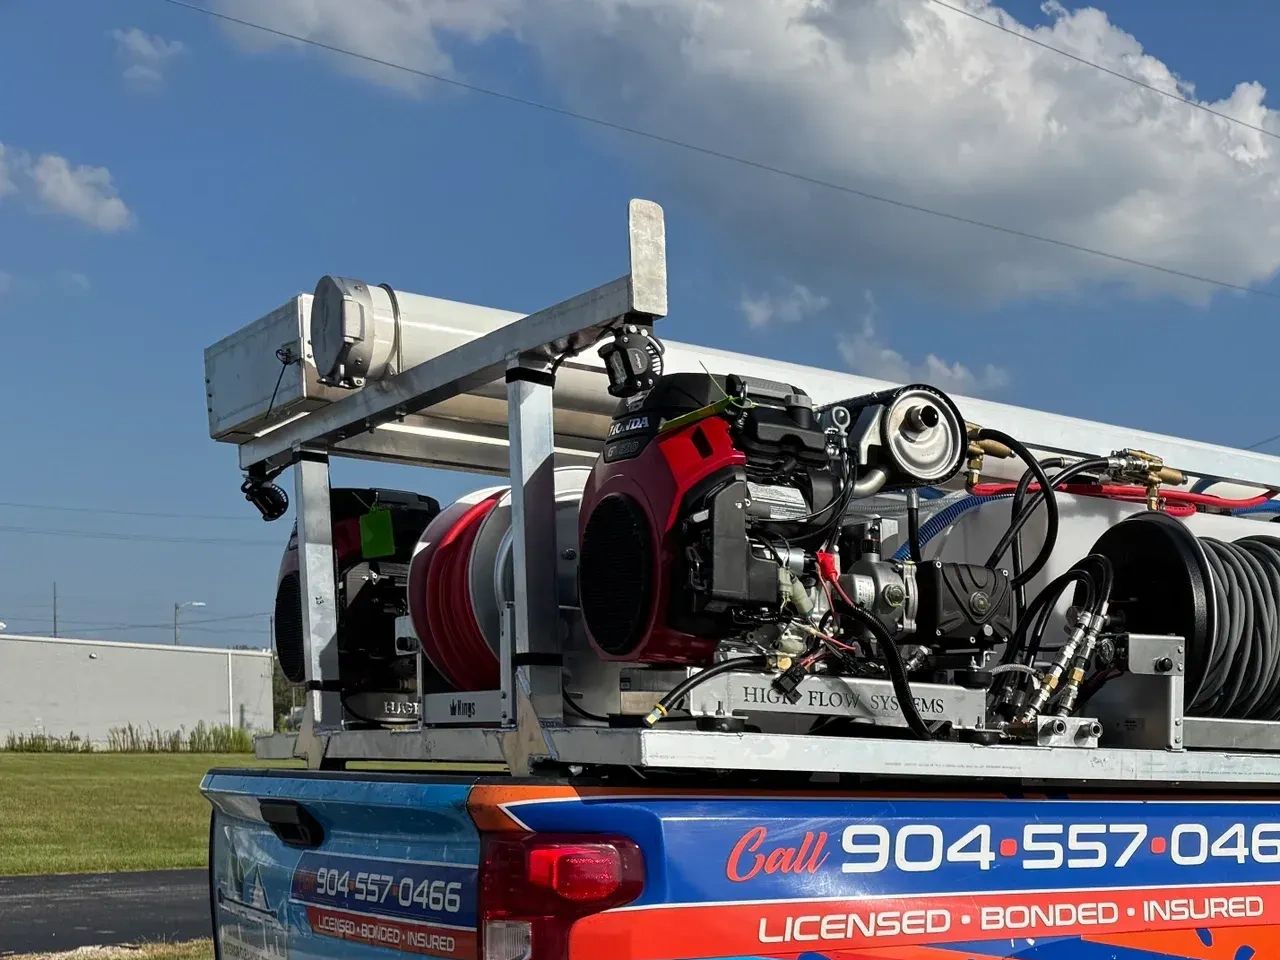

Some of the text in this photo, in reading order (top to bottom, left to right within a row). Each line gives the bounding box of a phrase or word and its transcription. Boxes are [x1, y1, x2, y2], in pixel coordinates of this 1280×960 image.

[457, 700, 476, 718] Kings
[744, 687, 944, 713] HIG FLOW SYSEMS
[726, 825, 831, 883] Call
[318, 914, 455, 952] LICENSED BONDED INSURED
[758, 896, 1263, 944] LICENSED BONDED INSURED
